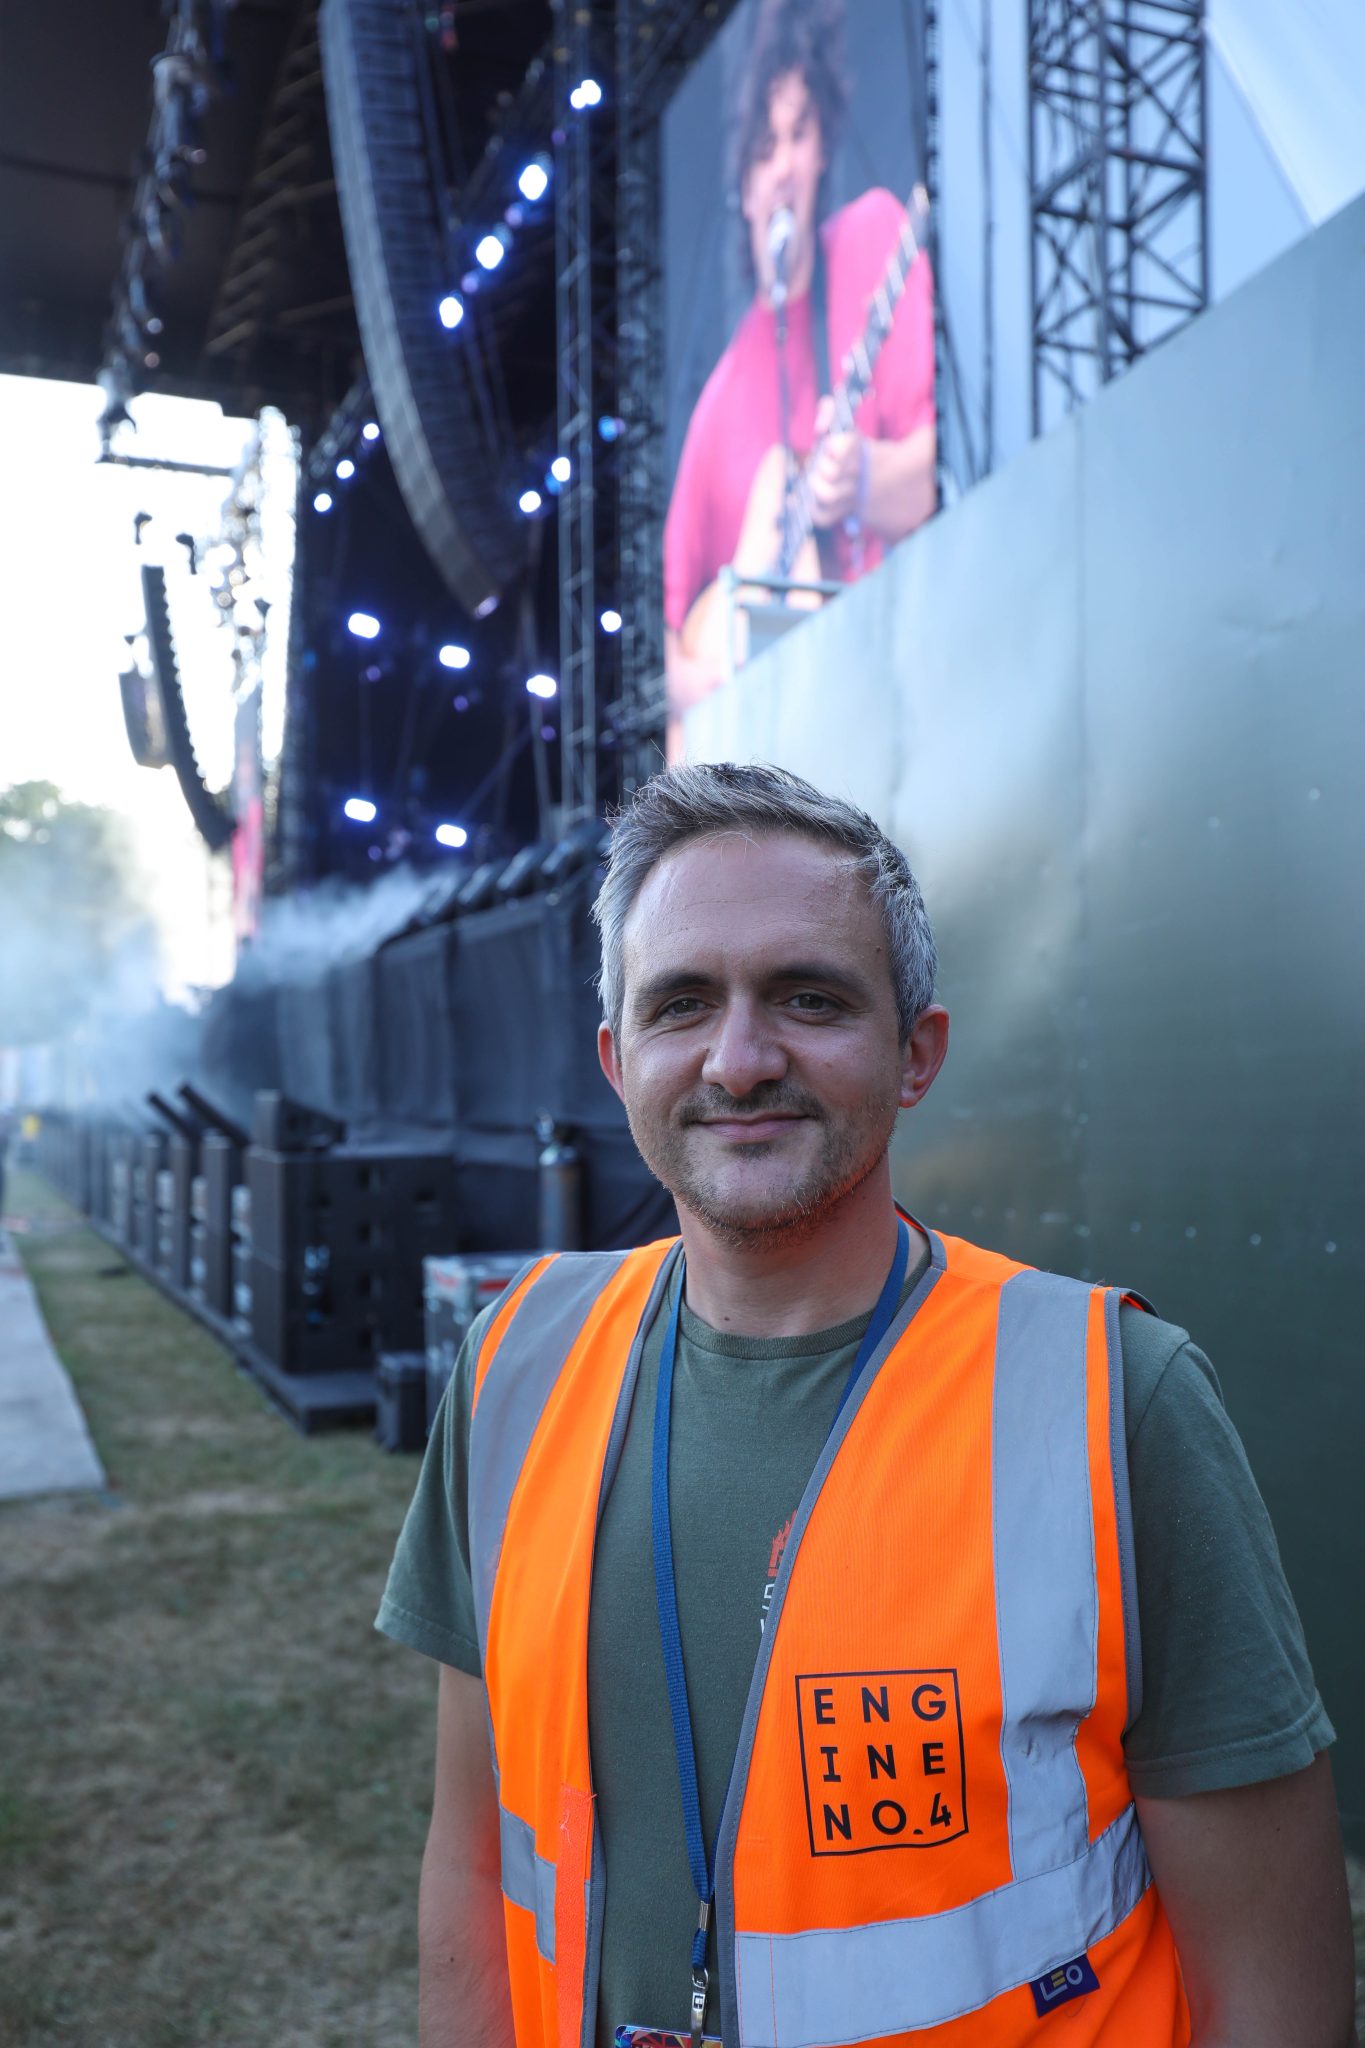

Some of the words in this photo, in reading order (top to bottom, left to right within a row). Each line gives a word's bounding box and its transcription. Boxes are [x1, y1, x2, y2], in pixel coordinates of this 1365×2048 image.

[813, 1683, 947, 1725] ENG
[820, 1742, 946, 1783] INE
[1040, 1965, 1083, 2001] LEO
